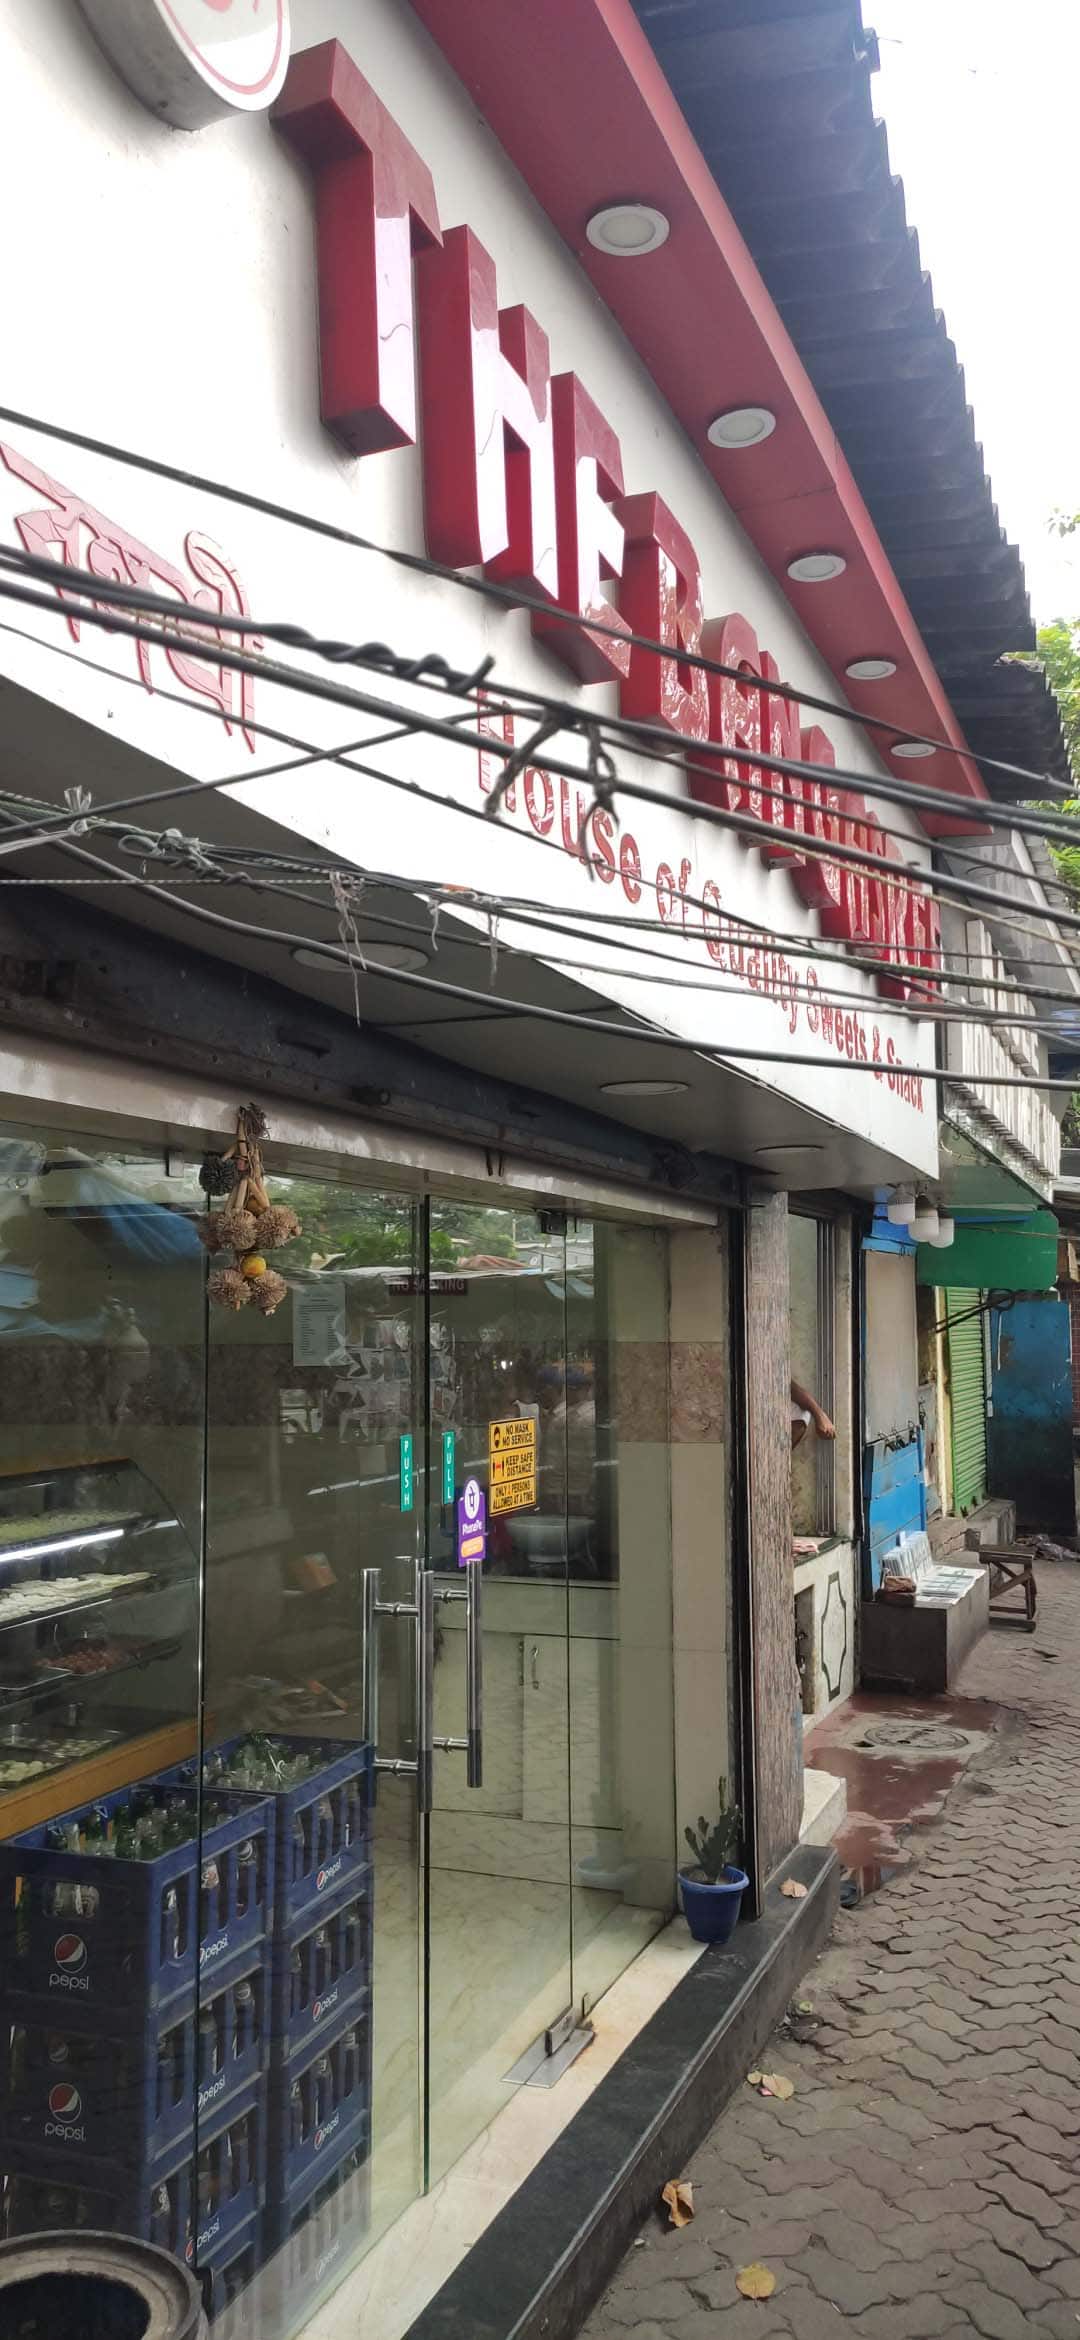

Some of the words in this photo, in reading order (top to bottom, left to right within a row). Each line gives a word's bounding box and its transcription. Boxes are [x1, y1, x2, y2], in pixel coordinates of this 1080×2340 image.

[272, 38, 634, 686] THE
[476, 686, 642, 904] House
[655, 857, 692, 942] of
[702, 879, 800, 1035] Quality
[806, 965, 868, 1063] Sweets
[872, 1024, 884, 1083] &
[886, 1037, 924, 1113] Snack
[413, 1278, 465, 1291] SMKING
[505, 1424, 514, 1435] NO
[514, 1422, 530, 1434] MASK
[511, 1432, 533, 1446] SERVICE
[505, 1454, 520, 1467] KEEP
[520, 1451, 534, 1464] SAFE
[203, 1933, 229, 1964] pepsi
[49, 1973, 90, 1991] pepsi
[202, 2075, 226, 2105] pepsi
[44, 2121, 87, 2142] pepsi
[196, 2217, 220, 2249] pepsi
